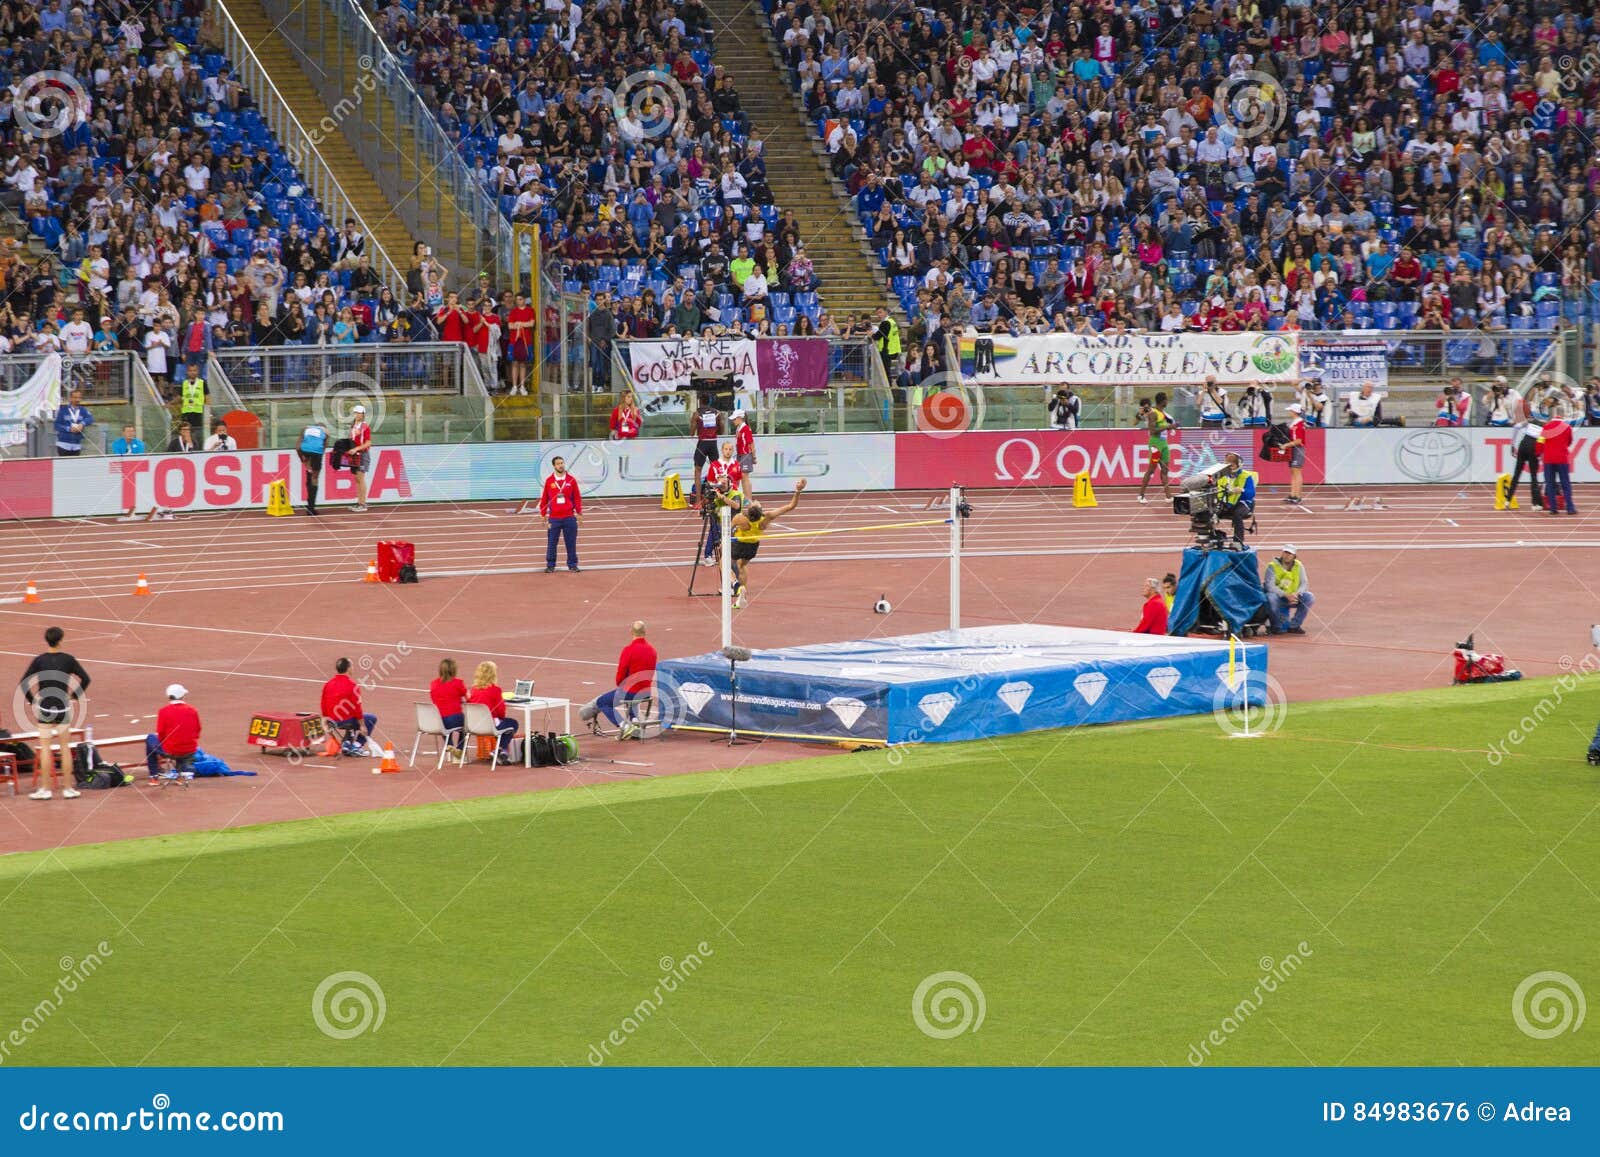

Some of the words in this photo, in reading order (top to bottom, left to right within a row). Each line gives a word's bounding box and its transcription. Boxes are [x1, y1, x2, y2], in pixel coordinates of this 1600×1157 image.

[661, 341, 691, 358] WE
[635, 357, 703, 383] GOLDEN
[710, 352, 755, 375] GALA
[1020, 350, 1249, 375] ARCOBALENO
[1332, 370, 1379, 379] DUILIA
[618, 451, 830, 482] LEUS
[672, 478, 681, 500] 8
[1081, 477, 1088, 497] 7
